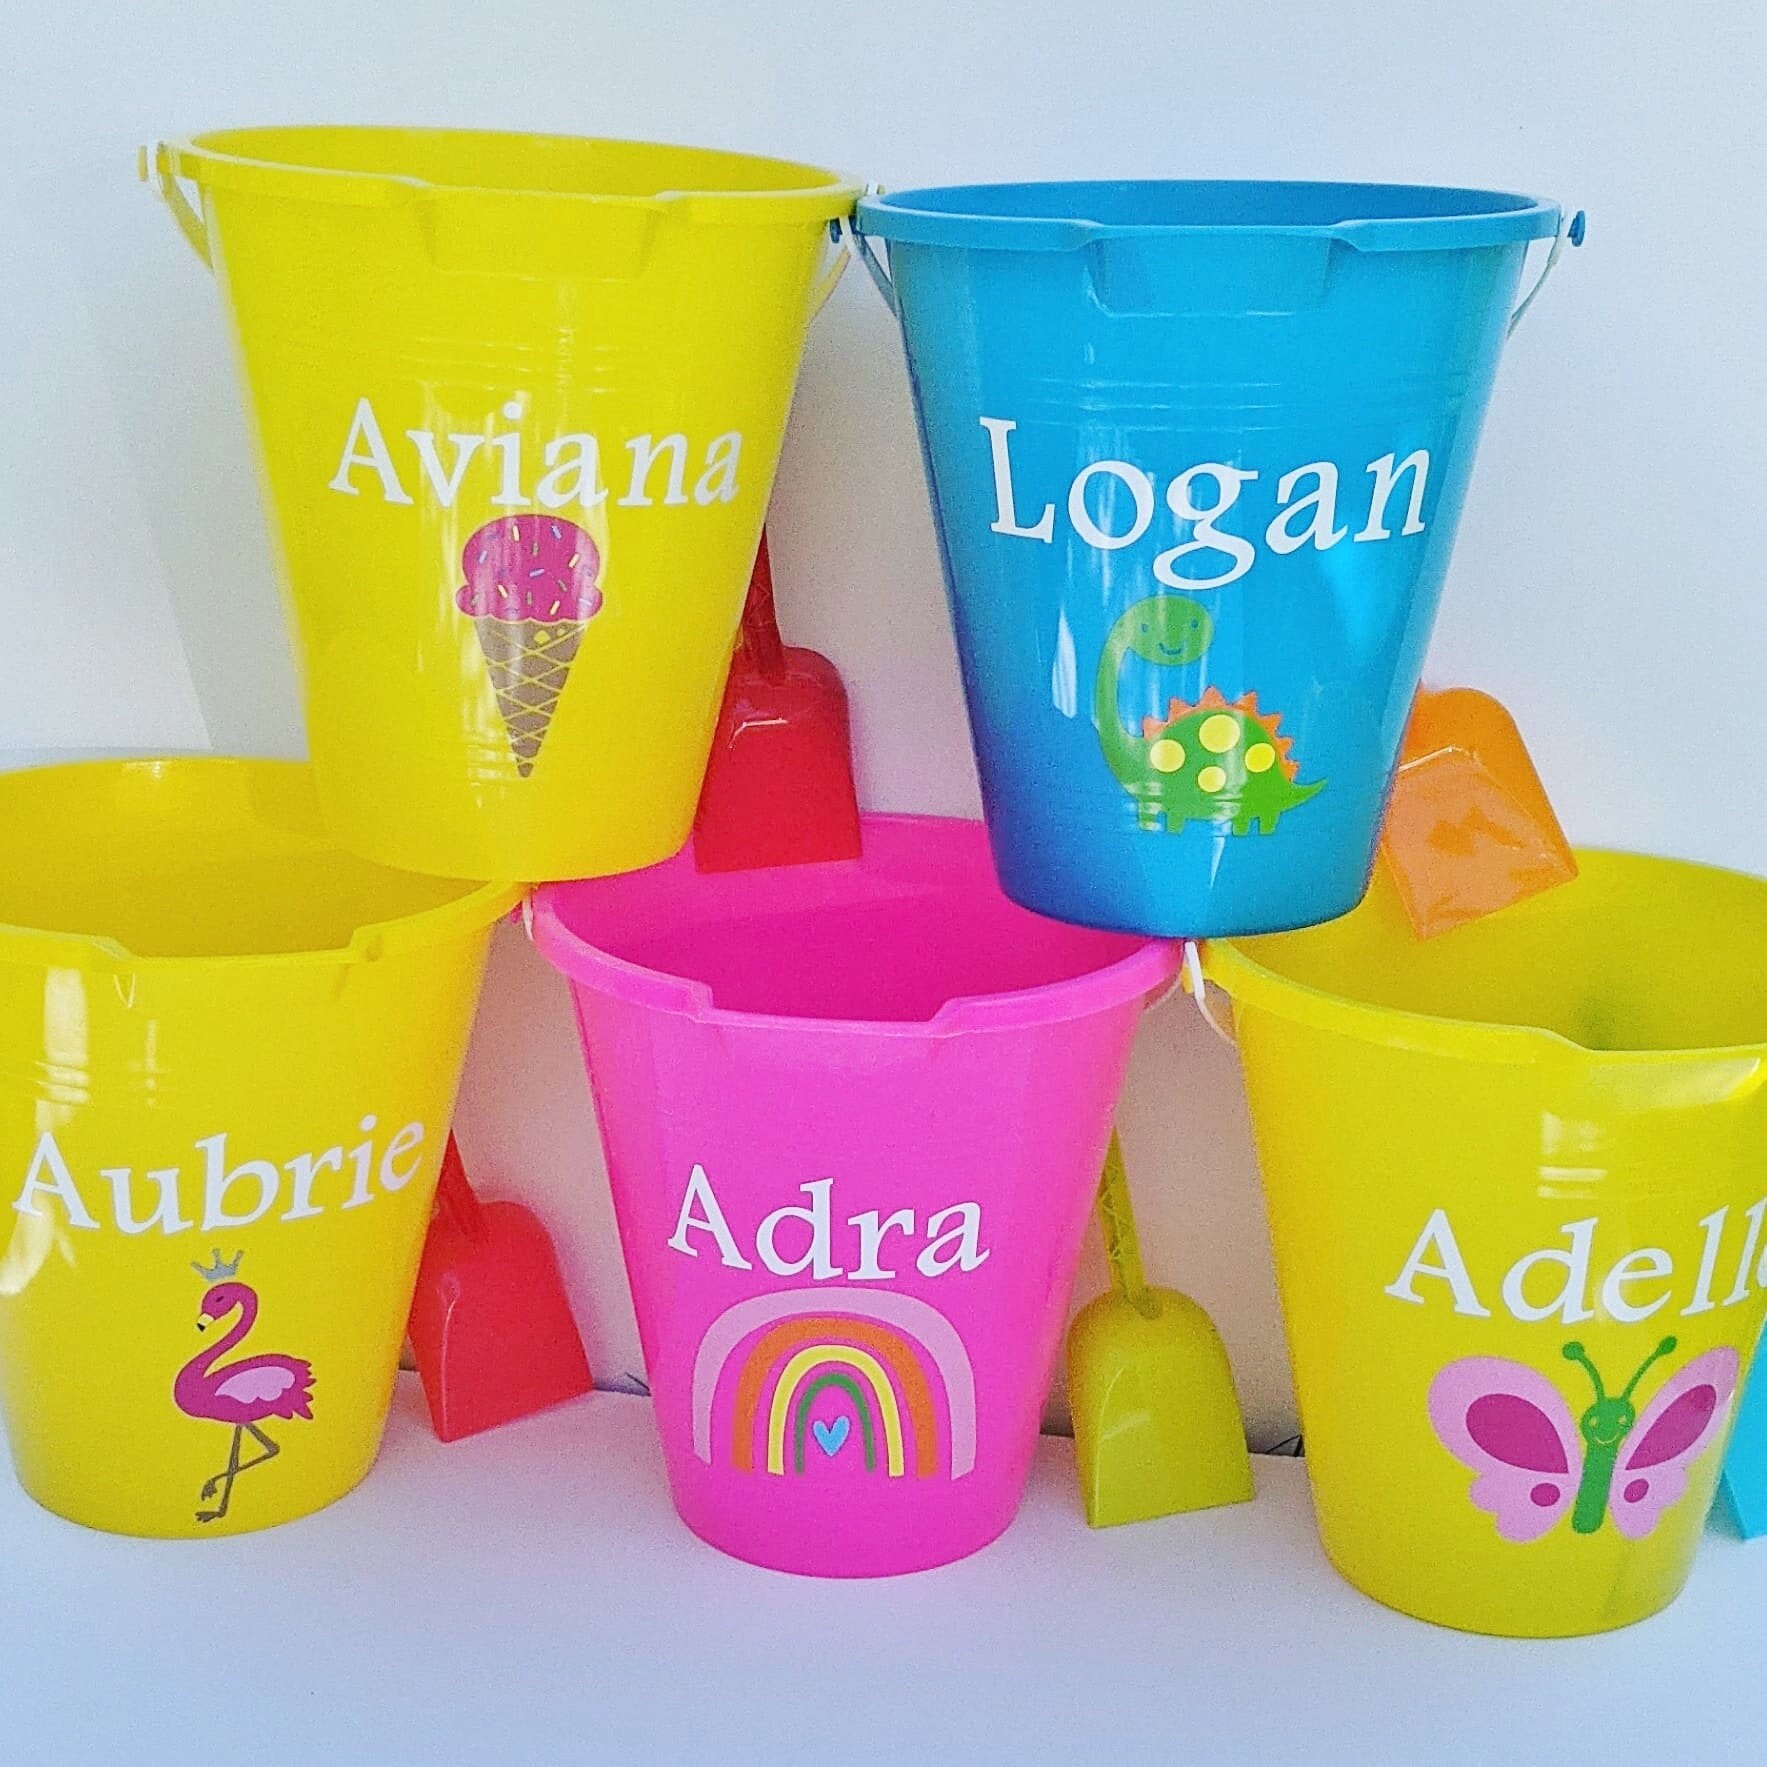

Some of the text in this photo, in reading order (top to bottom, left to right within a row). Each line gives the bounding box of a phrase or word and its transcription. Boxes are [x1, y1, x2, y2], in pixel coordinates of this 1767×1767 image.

[329, 397, 743, 508] Aviana
[980, 416, 1430, 590] Logan
[12, 1114, 425, 1235] Aubrie
[667, 1163, 991, 1281] Adra
[1384, 1197, 1767, 1325] Adell
